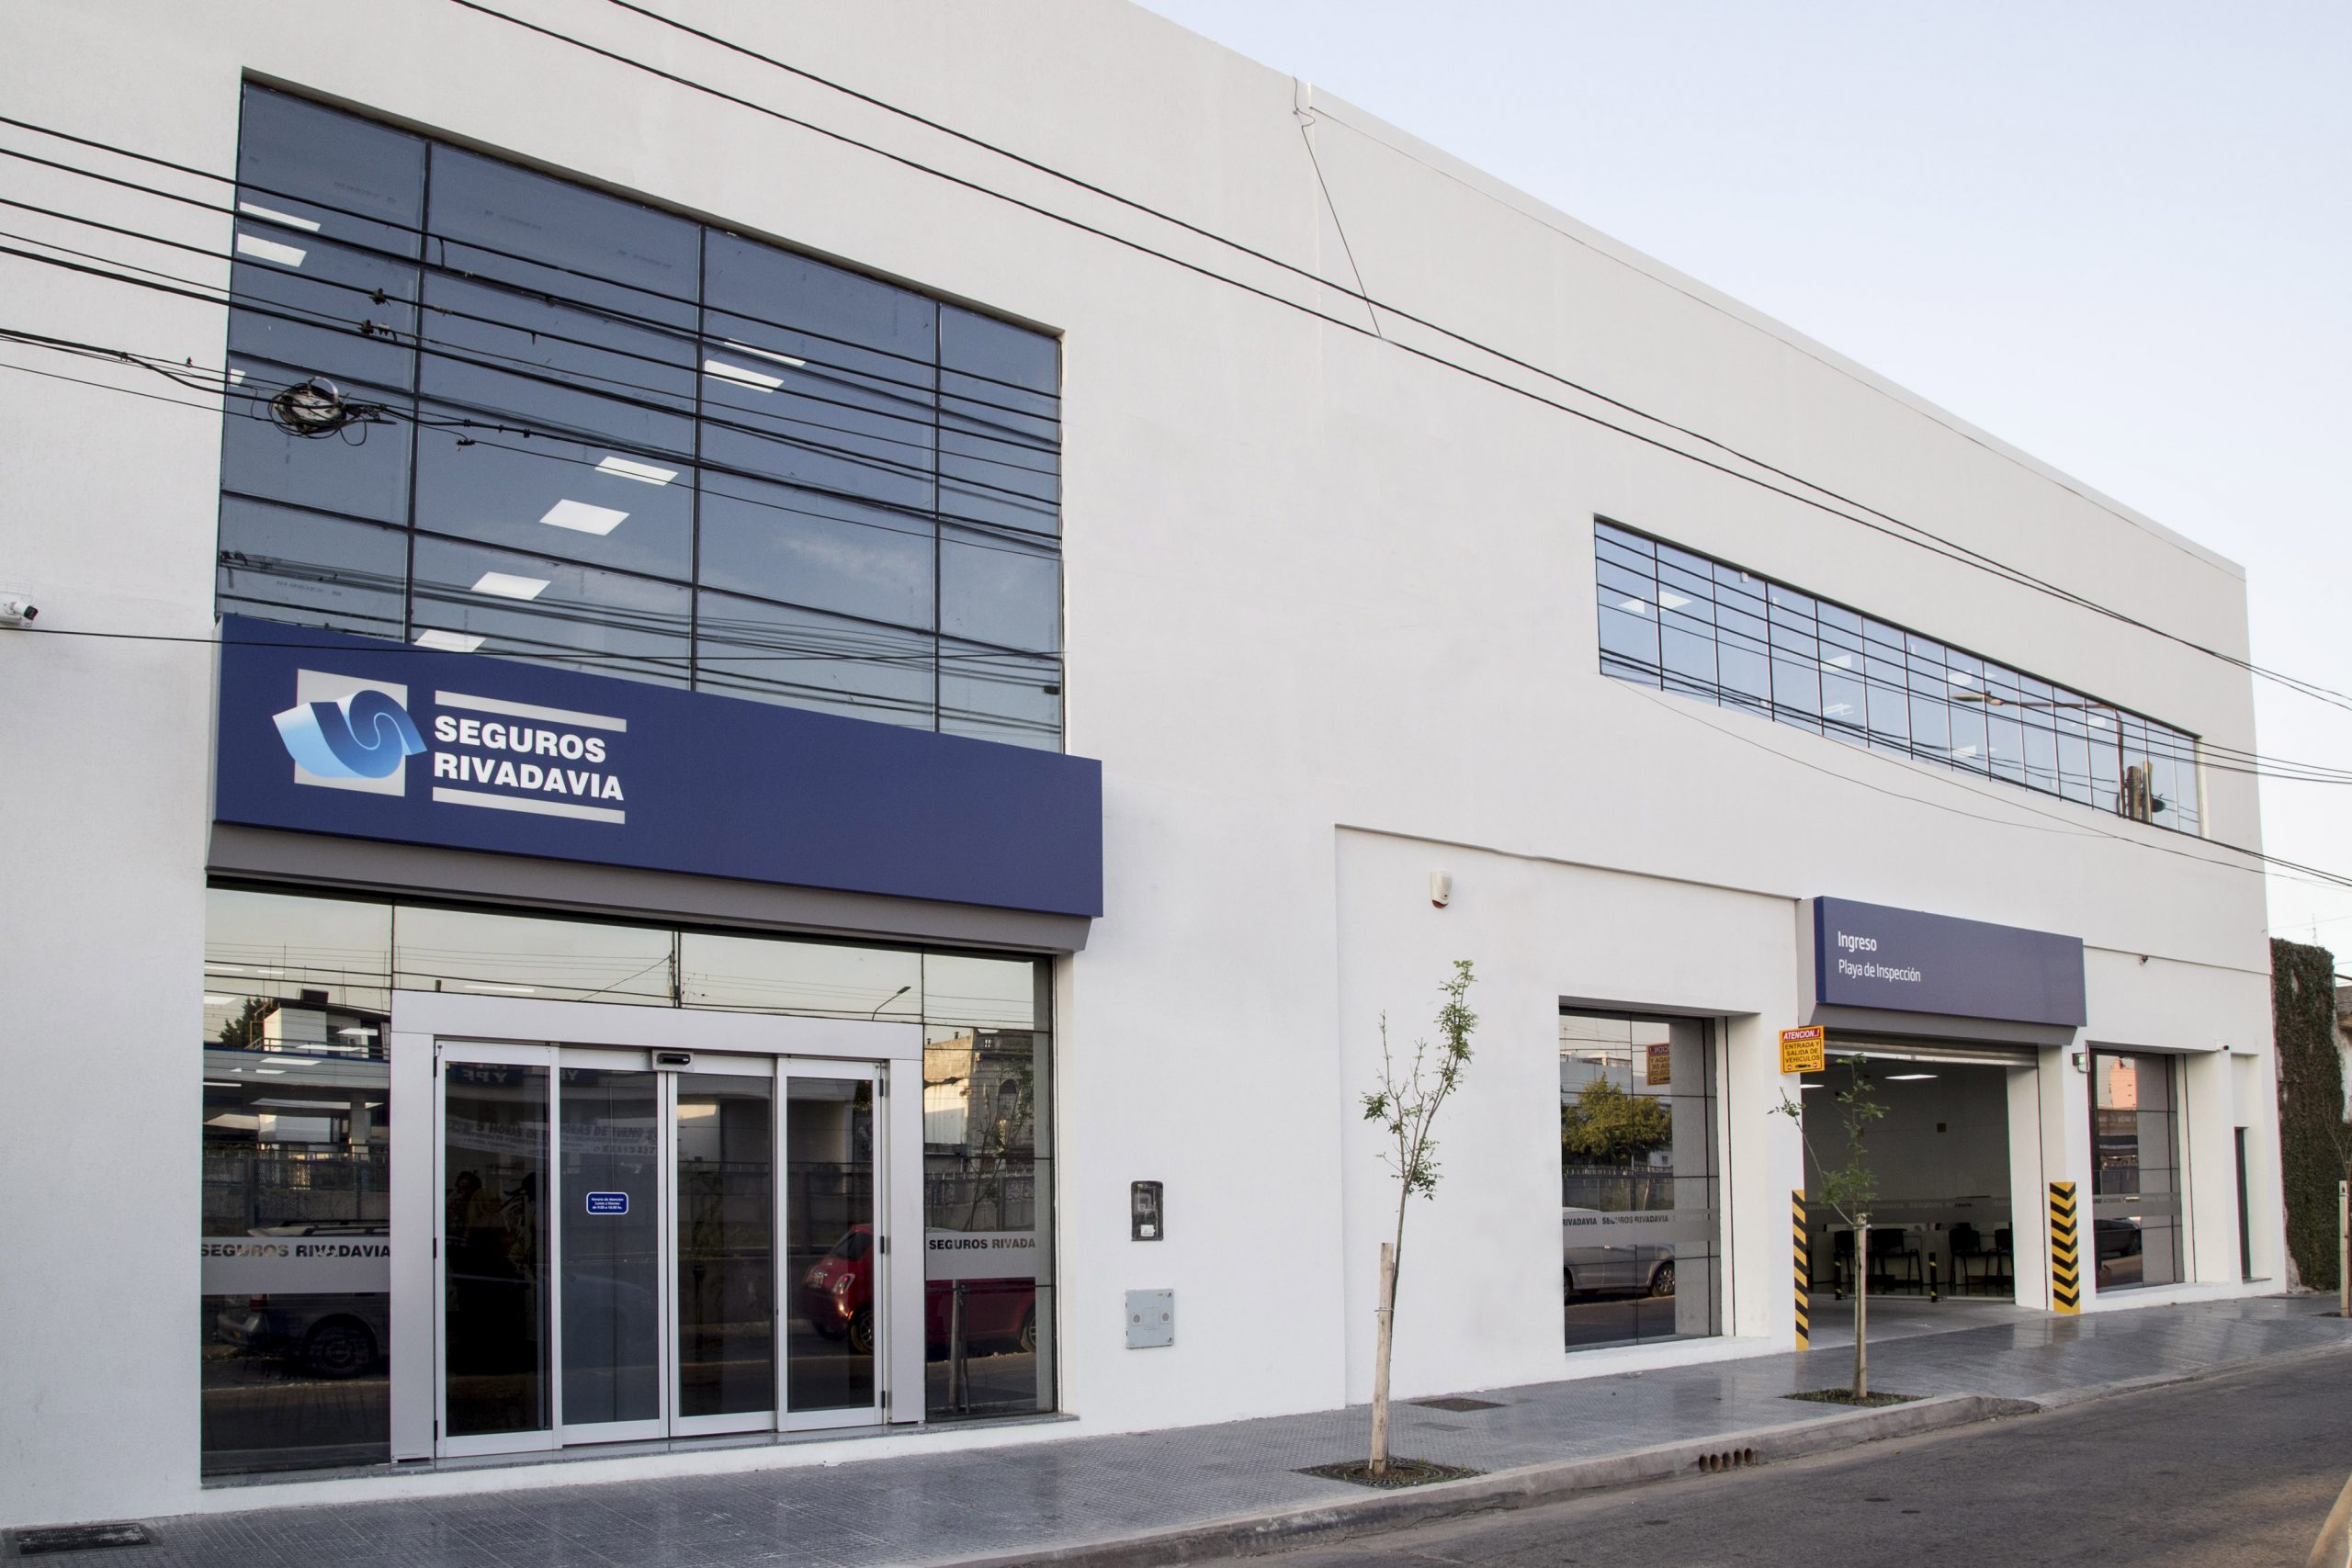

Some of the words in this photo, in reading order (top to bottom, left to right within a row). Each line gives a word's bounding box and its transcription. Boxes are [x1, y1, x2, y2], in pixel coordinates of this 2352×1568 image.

[435, 715, 606, 763] SEGUROS
[434, 752, 625, 802] RIVADAVIA
[1838, 931, 1877, 953] Ingreso
[1838, 959, 1863, 979] Playa
[1864, 962, 1875, 977] de
[1876, 964, 1921, 983] Inspección
[1785, 1042, 1815, 1050] ENTRADA
[1785, 1055, 1820, 1063] VEHICULOS
[1602, 1216, 1634, 1225] SEGROS
[1634, 1214, 1668, 1224] RIVADAVIA
[200, 1244, 288, 1258] SEGUROS
[295, 1244, 390, 1258] RIVADAVIA
[929, 1239, 989, 1250] SEGUROS
